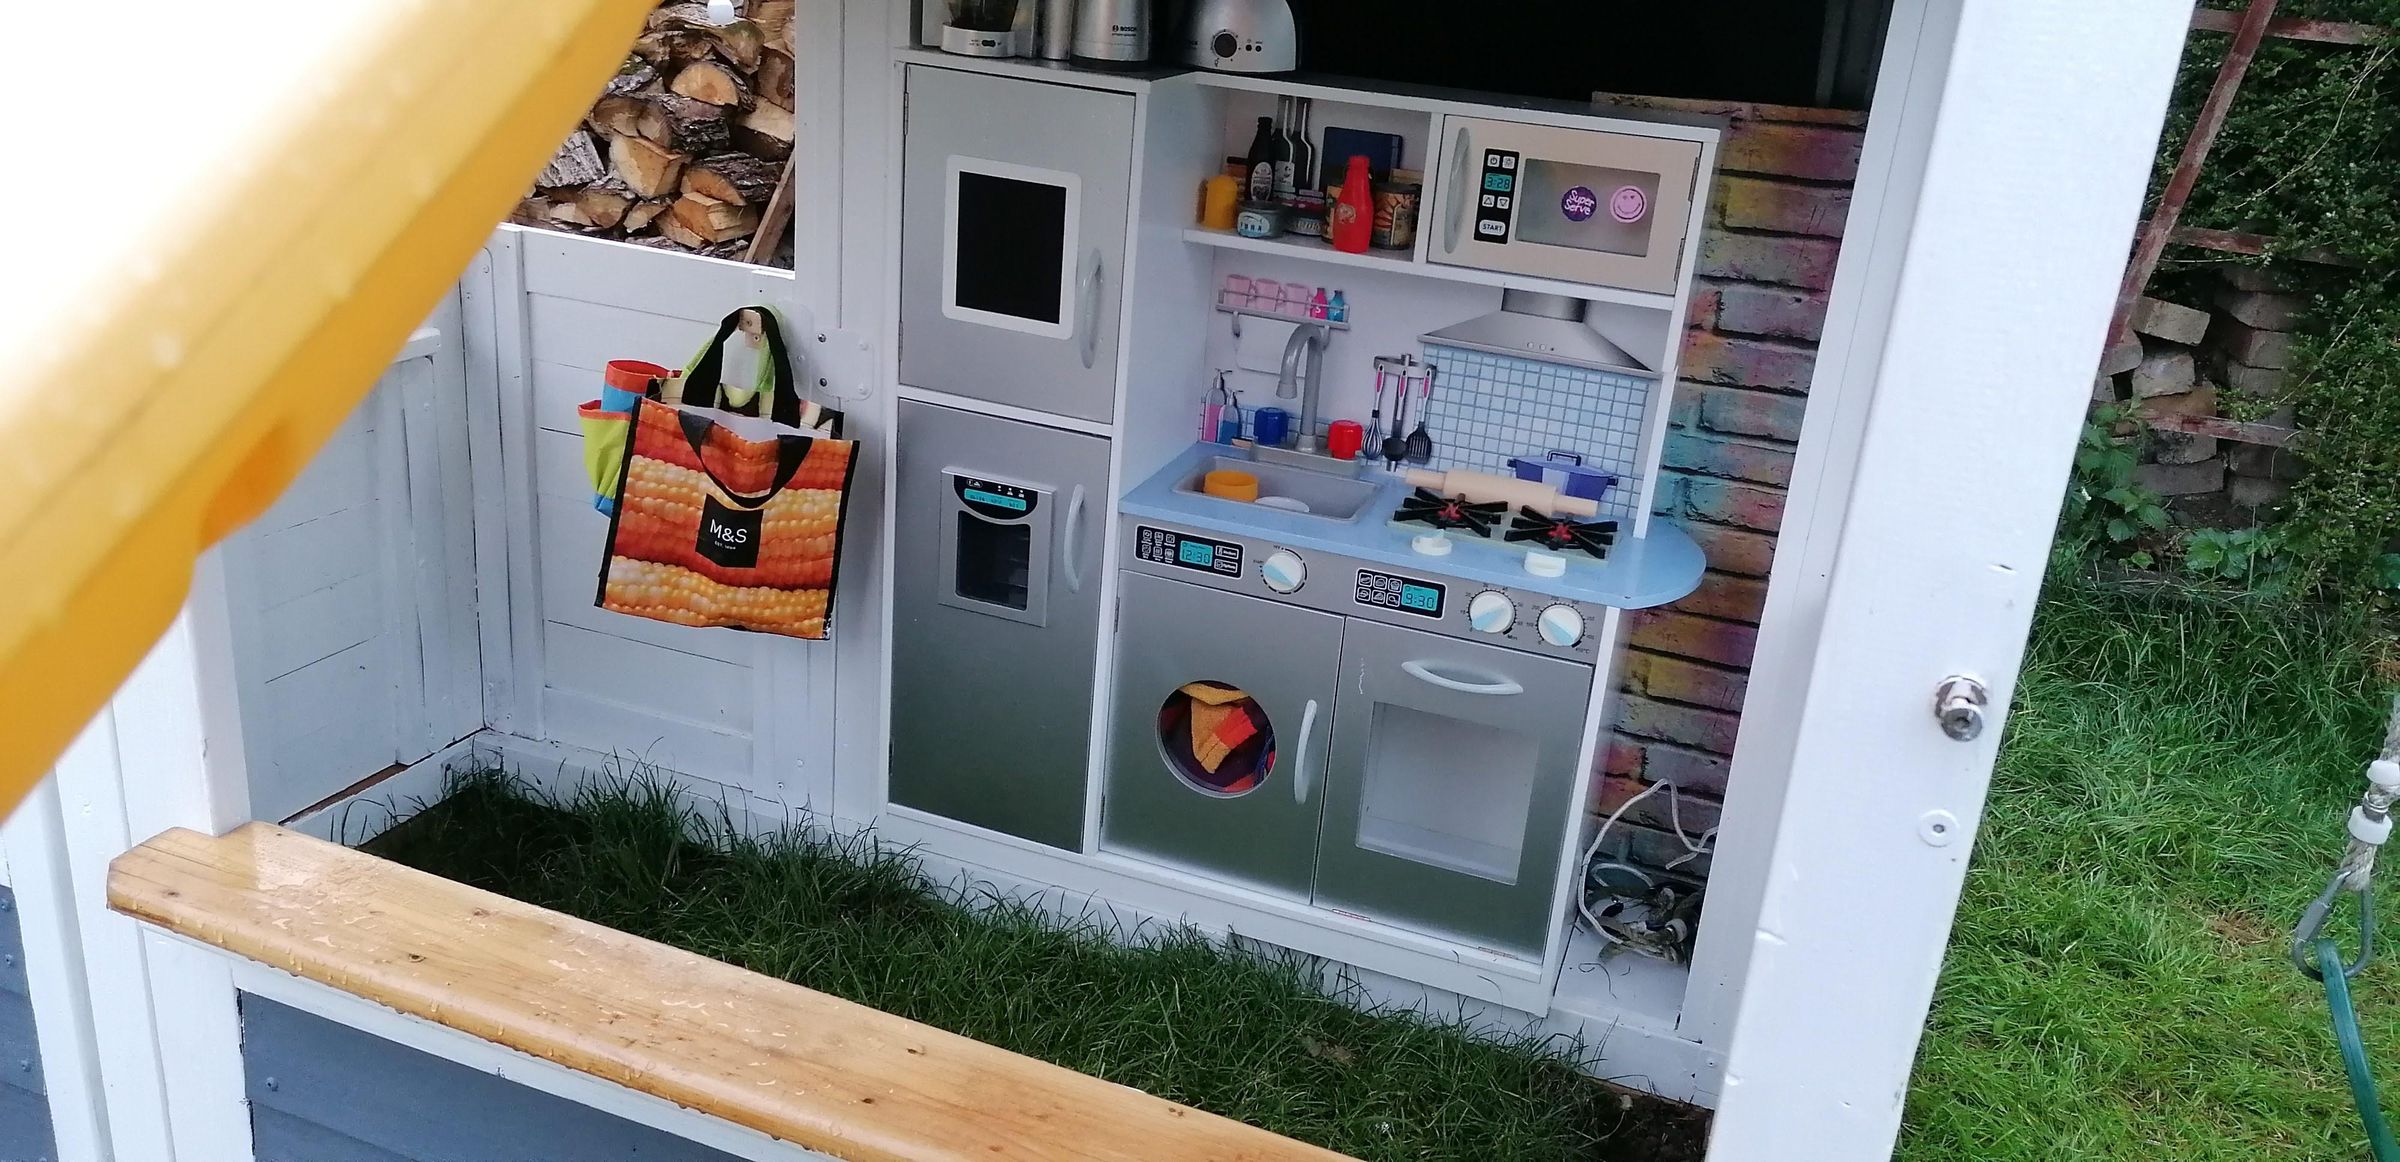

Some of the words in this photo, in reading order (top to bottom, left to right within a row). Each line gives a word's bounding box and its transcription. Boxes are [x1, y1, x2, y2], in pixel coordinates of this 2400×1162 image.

[1487, 177, 1510, 189] 3:28
[1570, 190, 1594, 205] Super
[1564, 201, 1591, 215] Serve
[1482, 223, 1502, 231] START
[710, 518, 747, 543] M&S
[1182, 549, 1210, 564] 12:30
[1405, 592, 1434, 608] 9:30
